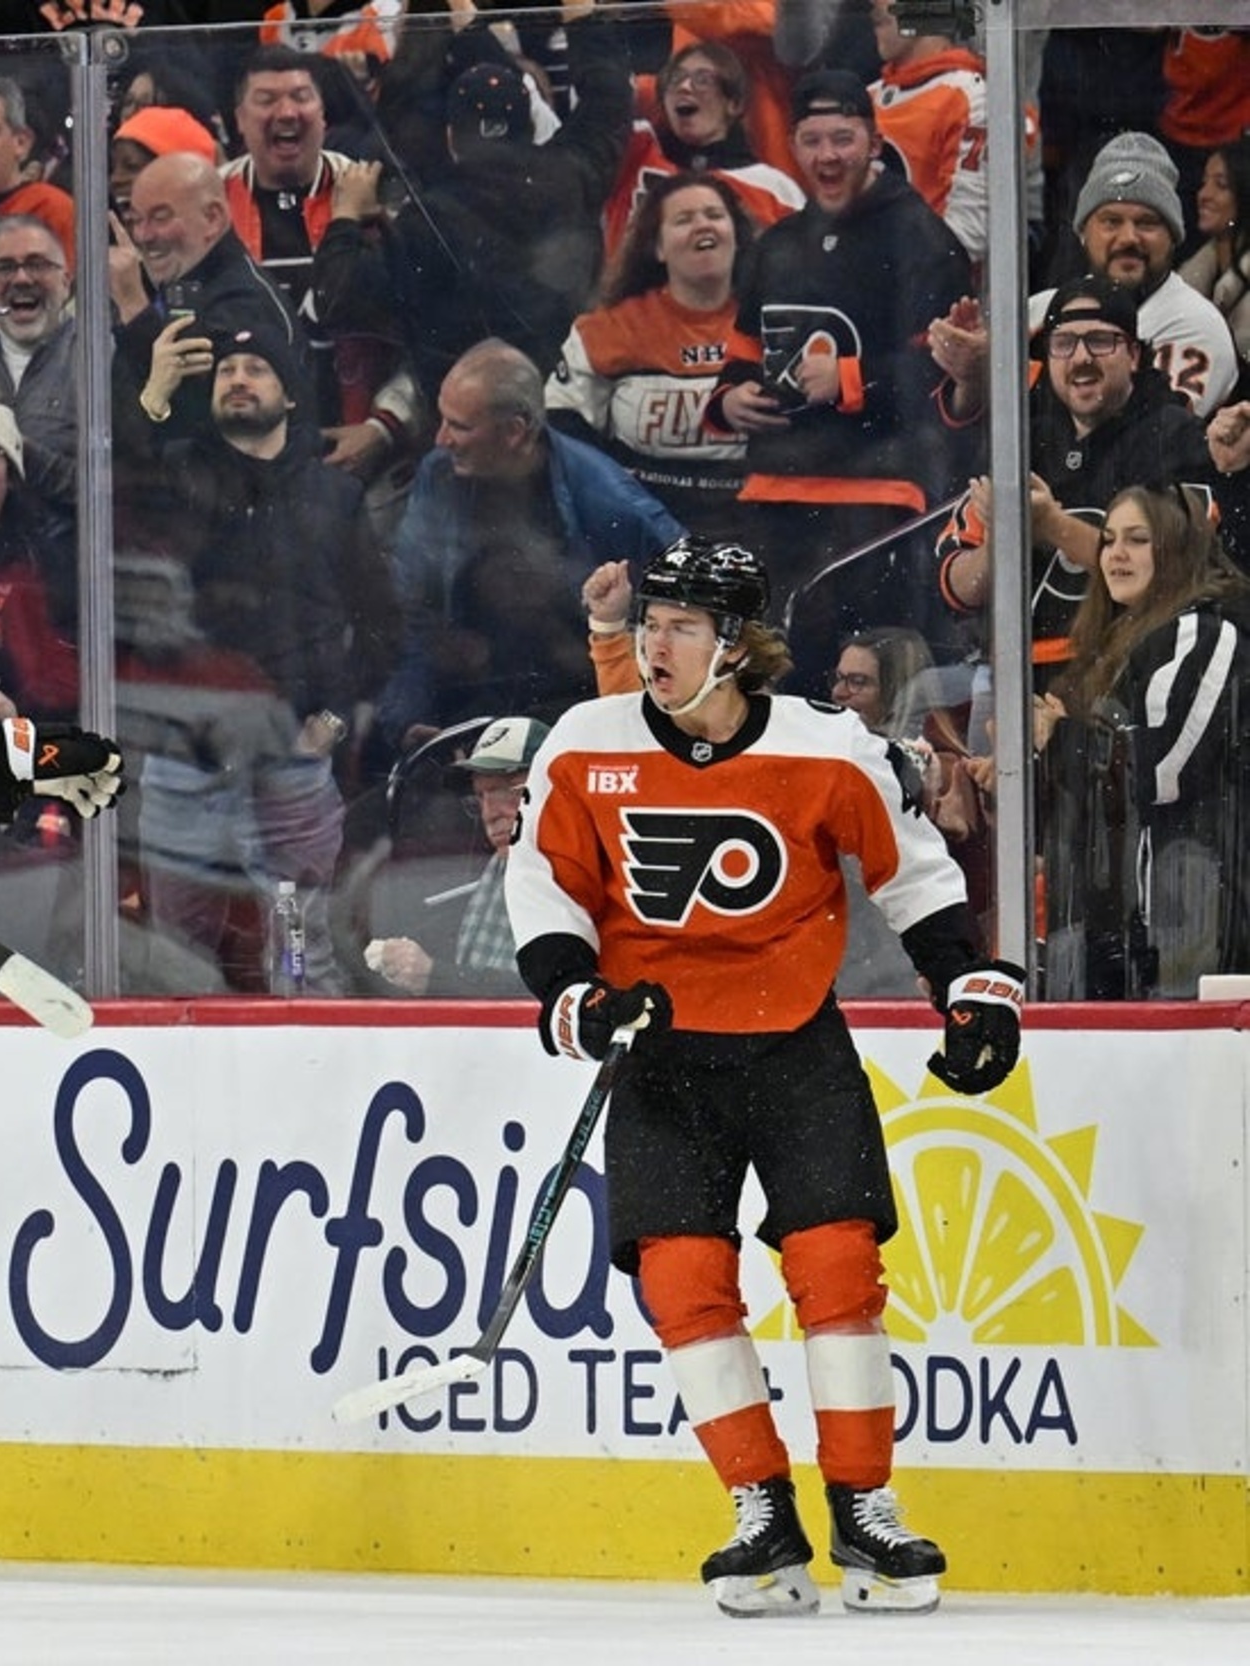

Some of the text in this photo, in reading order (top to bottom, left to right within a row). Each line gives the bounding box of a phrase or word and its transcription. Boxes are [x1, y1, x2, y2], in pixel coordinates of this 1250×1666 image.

[681, 344, 727, 365] NH
[1153, 342, 1210, 398] 12
[588, 771, 638, 794] IBX
[9, 1048, 658, 1374] Surfsid
[378, 1345, 538, 1432] ICED
[890, 1353, 1077, 1445] ODKA
